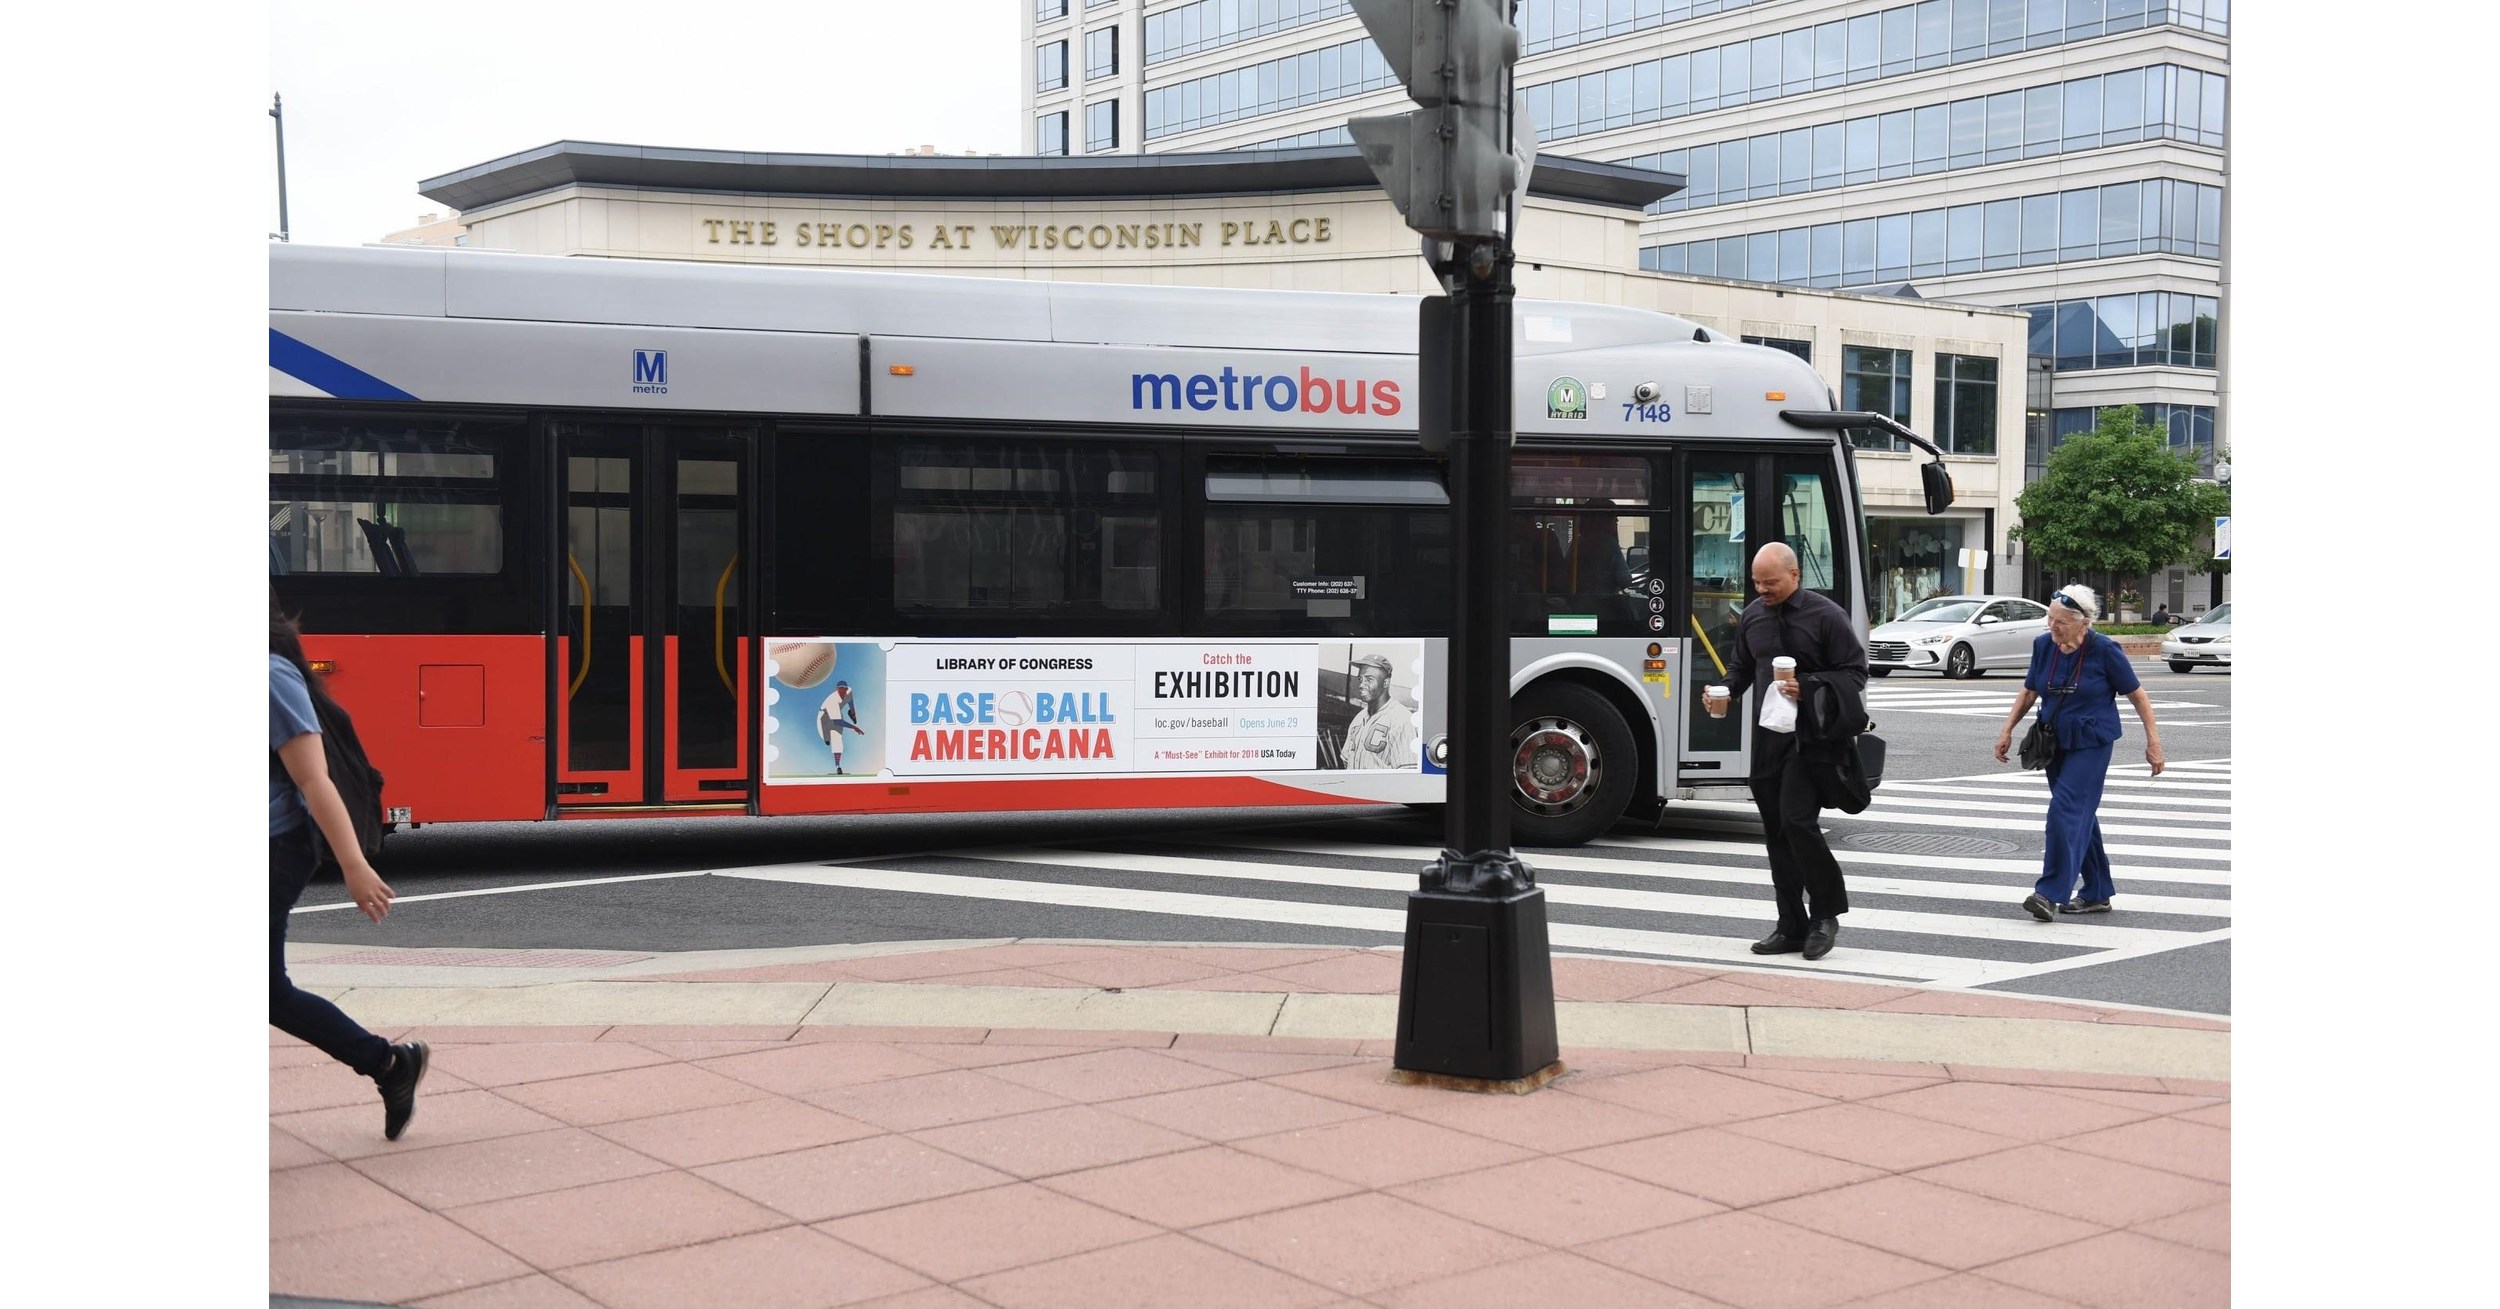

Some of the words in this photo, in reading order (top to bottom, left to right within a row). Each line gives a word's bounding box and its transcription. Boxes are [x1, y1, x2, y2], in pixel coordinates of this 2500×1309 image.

[703, 218, 778, 245] THE
[796, 222, 914, 249] SHOPS
[929, 224, 975, 249] AT
[990, 222, 1203, 250] WISCONSIN
[1221, 217, 1332, 246] PLACE
[636, 351, 664, 383] M
[632, 385, 668, 394] metro
[1132, 366, 1402, 417] metrobus
[1560, 389, 1574, 403] M
[1550, 411, 1584, 420] HYBRID
[1622, 403, 1671, 423] 7148
[936, 658, 995, 670] LIBRARY
[999, 658, 1016, 670] OF
[1019, 658, 1093, 670] CONGRESS
[1203, 653, 1233, 665] Catch
[1236, 653, 1252, 664] the
[1154, 671, 1299, 698] EXHIBITION
[1154, 717, 1229, 730] loc.gov/baseball
[1239, 718, 1266, 730] Opens
[1266, 718, 1285, 728] June
[1287, 717, 1298, 728] 29
[910, 728, 1116, 761] AMERICANA
[1154, 751, 1160, 759] A
[1204, 750, 1228, 759] Exhibit
[1229, 750, 1239, 759] for
[1241, 750, 1259, 759] 2018
[1260, 749, 1274, 758] USA
[1276, 749, 1296, 759] Today
